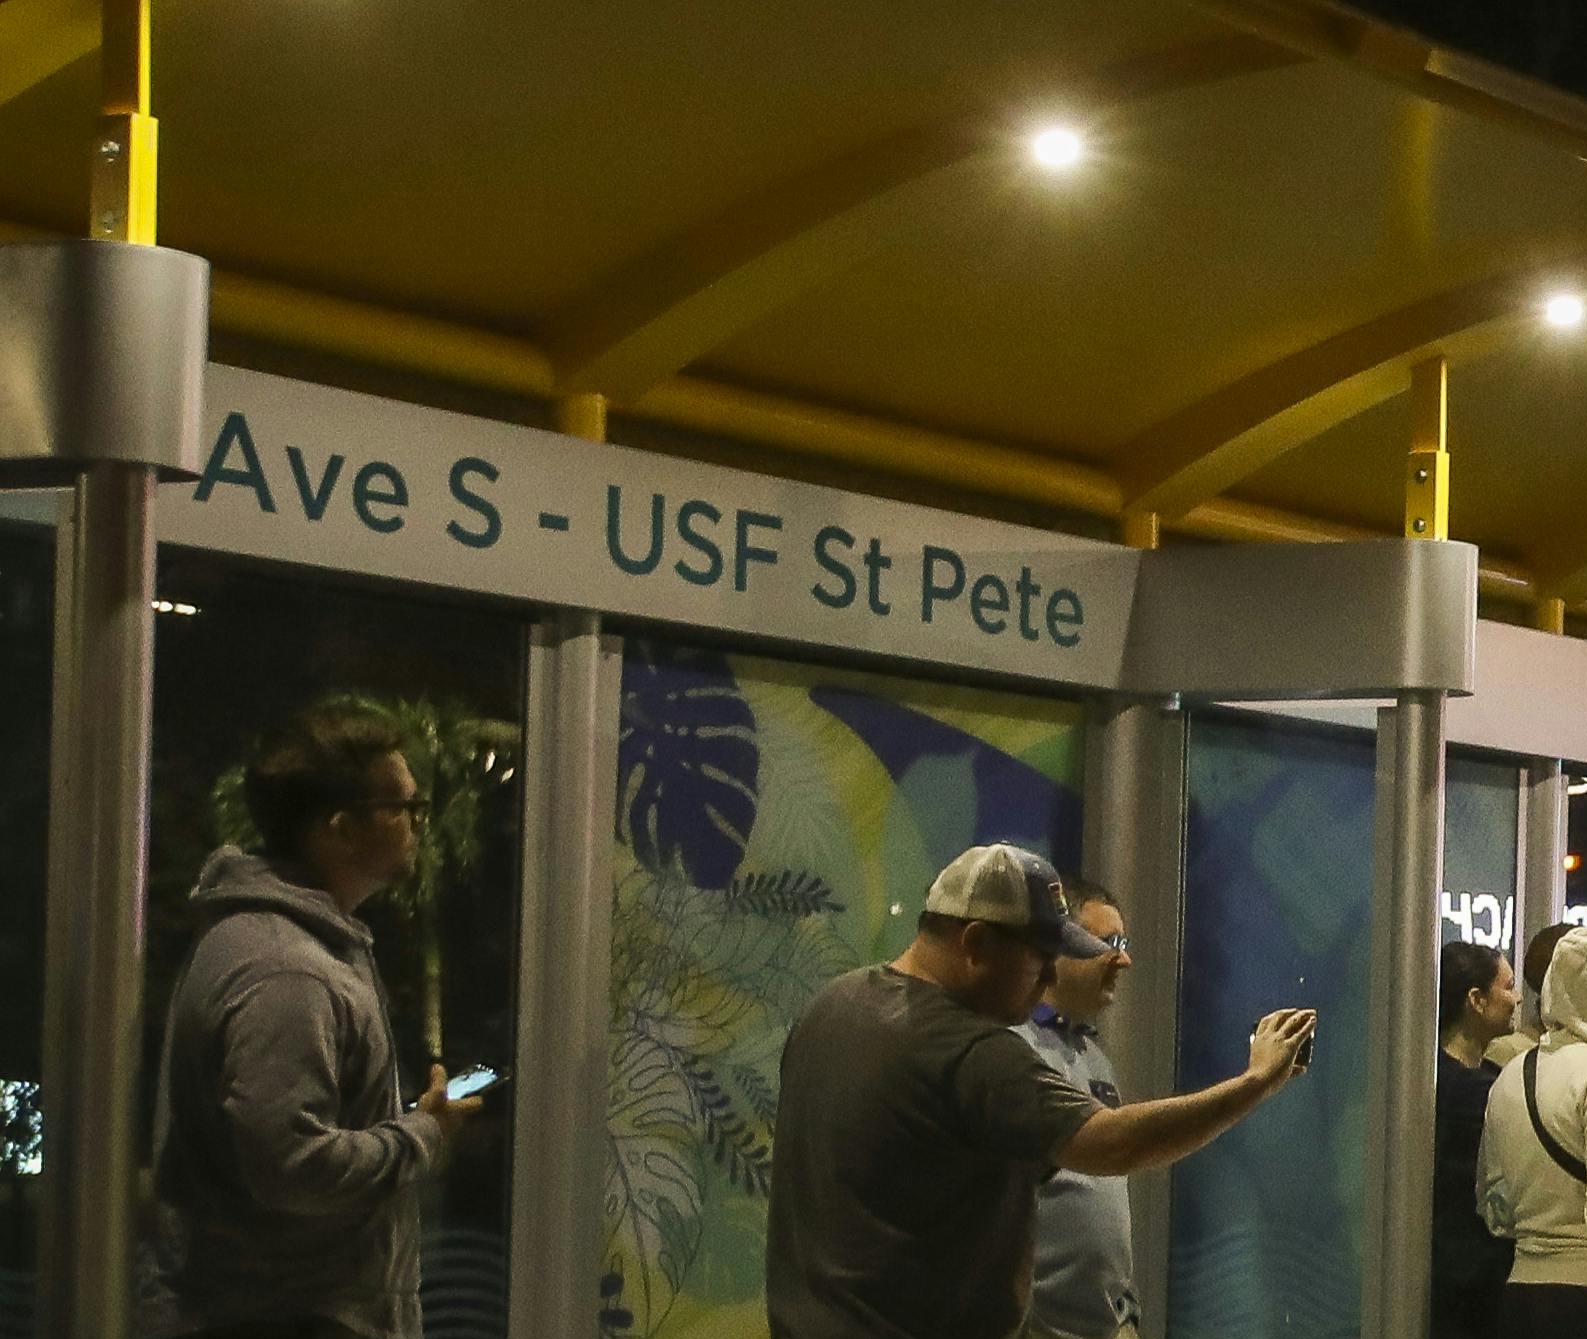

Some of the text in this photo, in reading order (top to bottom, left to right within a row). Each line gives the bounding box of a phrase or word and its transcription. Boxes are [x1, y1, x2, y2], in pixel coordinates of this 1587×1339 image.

[192, 411, 1085, 647] Ave S - USF St Pete
